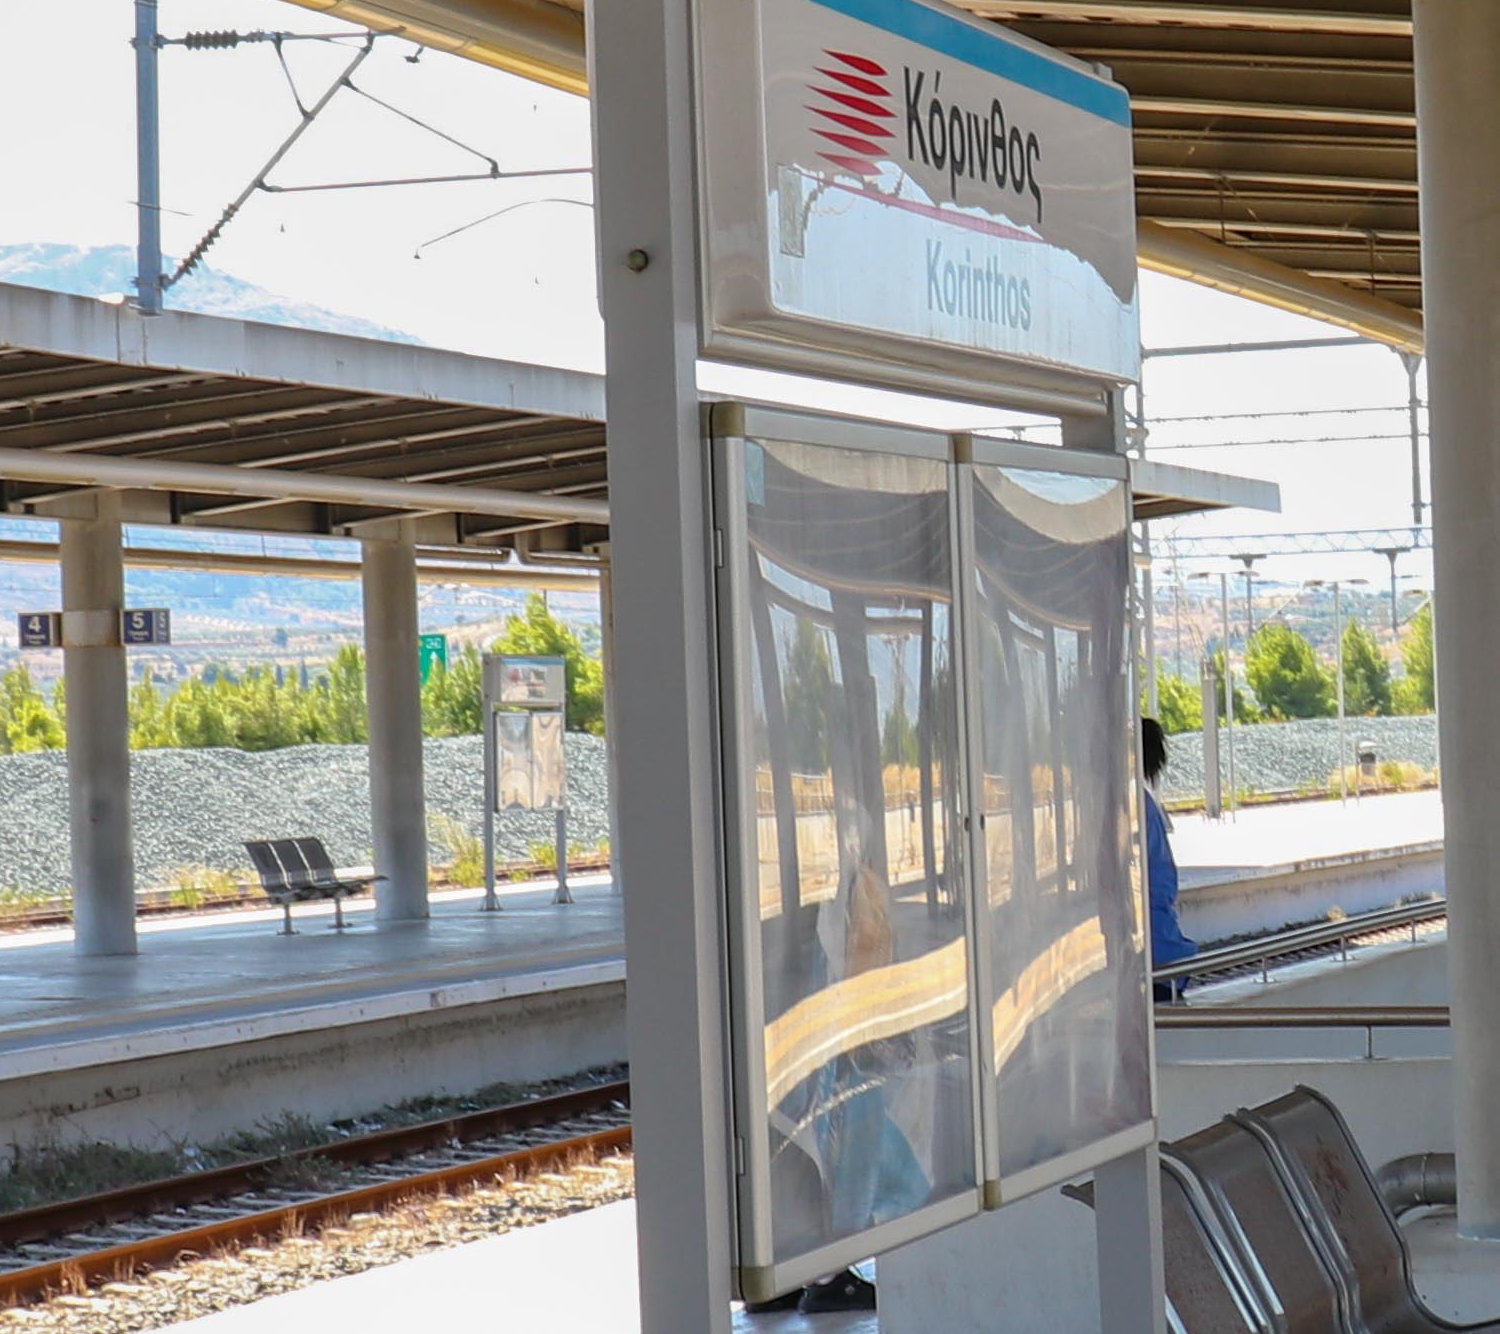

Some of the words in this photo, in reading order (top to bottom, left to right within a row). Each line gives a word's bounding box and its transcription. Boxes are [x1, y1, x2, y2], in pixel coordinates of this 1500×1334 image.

[903, 65, 1043, 224] Κόρινθος
[926, 240, 1032, 333] Korinthos
[28, 616, 41, 633] 4
[132, 612, 144, 629] 5
